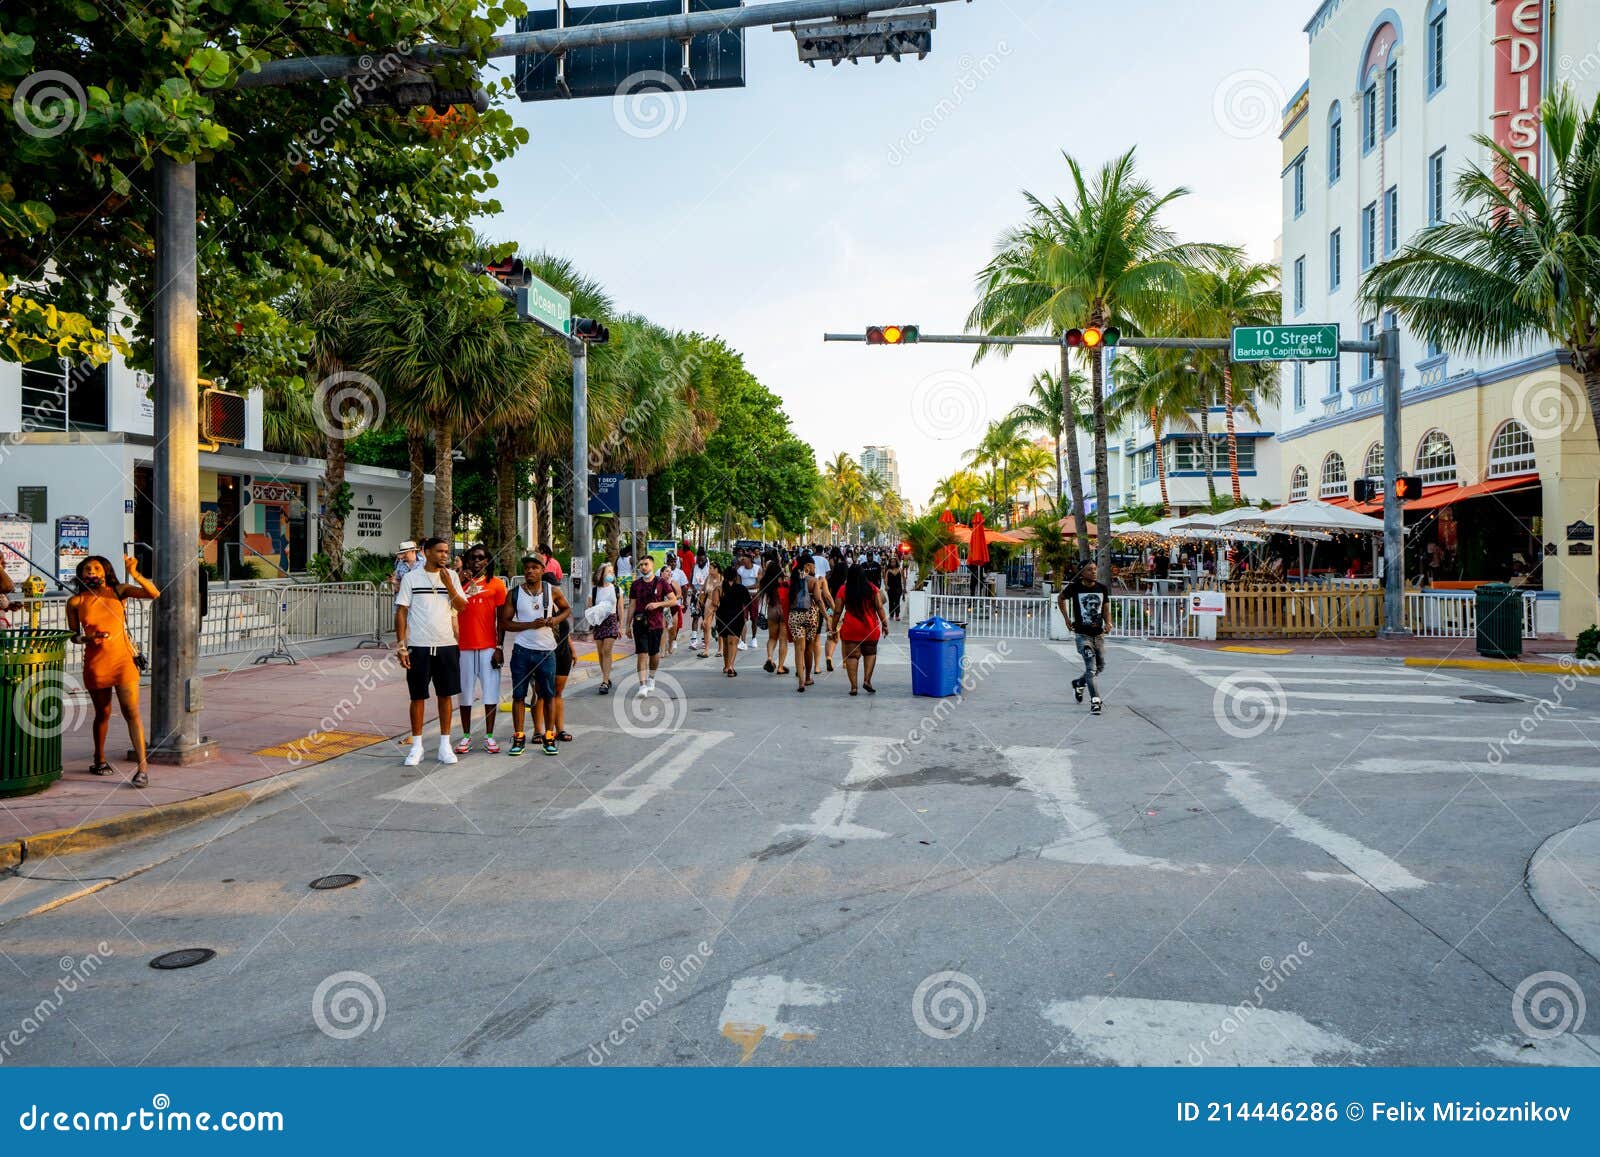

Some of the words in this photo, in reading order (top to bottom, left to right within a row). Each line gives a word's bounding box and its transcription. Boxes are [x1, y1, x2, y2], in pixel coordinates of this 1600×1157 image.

[533, 288, 555, 317] Ocean
[1255, 329, 1275, 346] 10
[1280, 331, 1323, 345] Street
[1237, 347, 1270, 356] Barbara
[1314, 346, 1333, 356] Way
